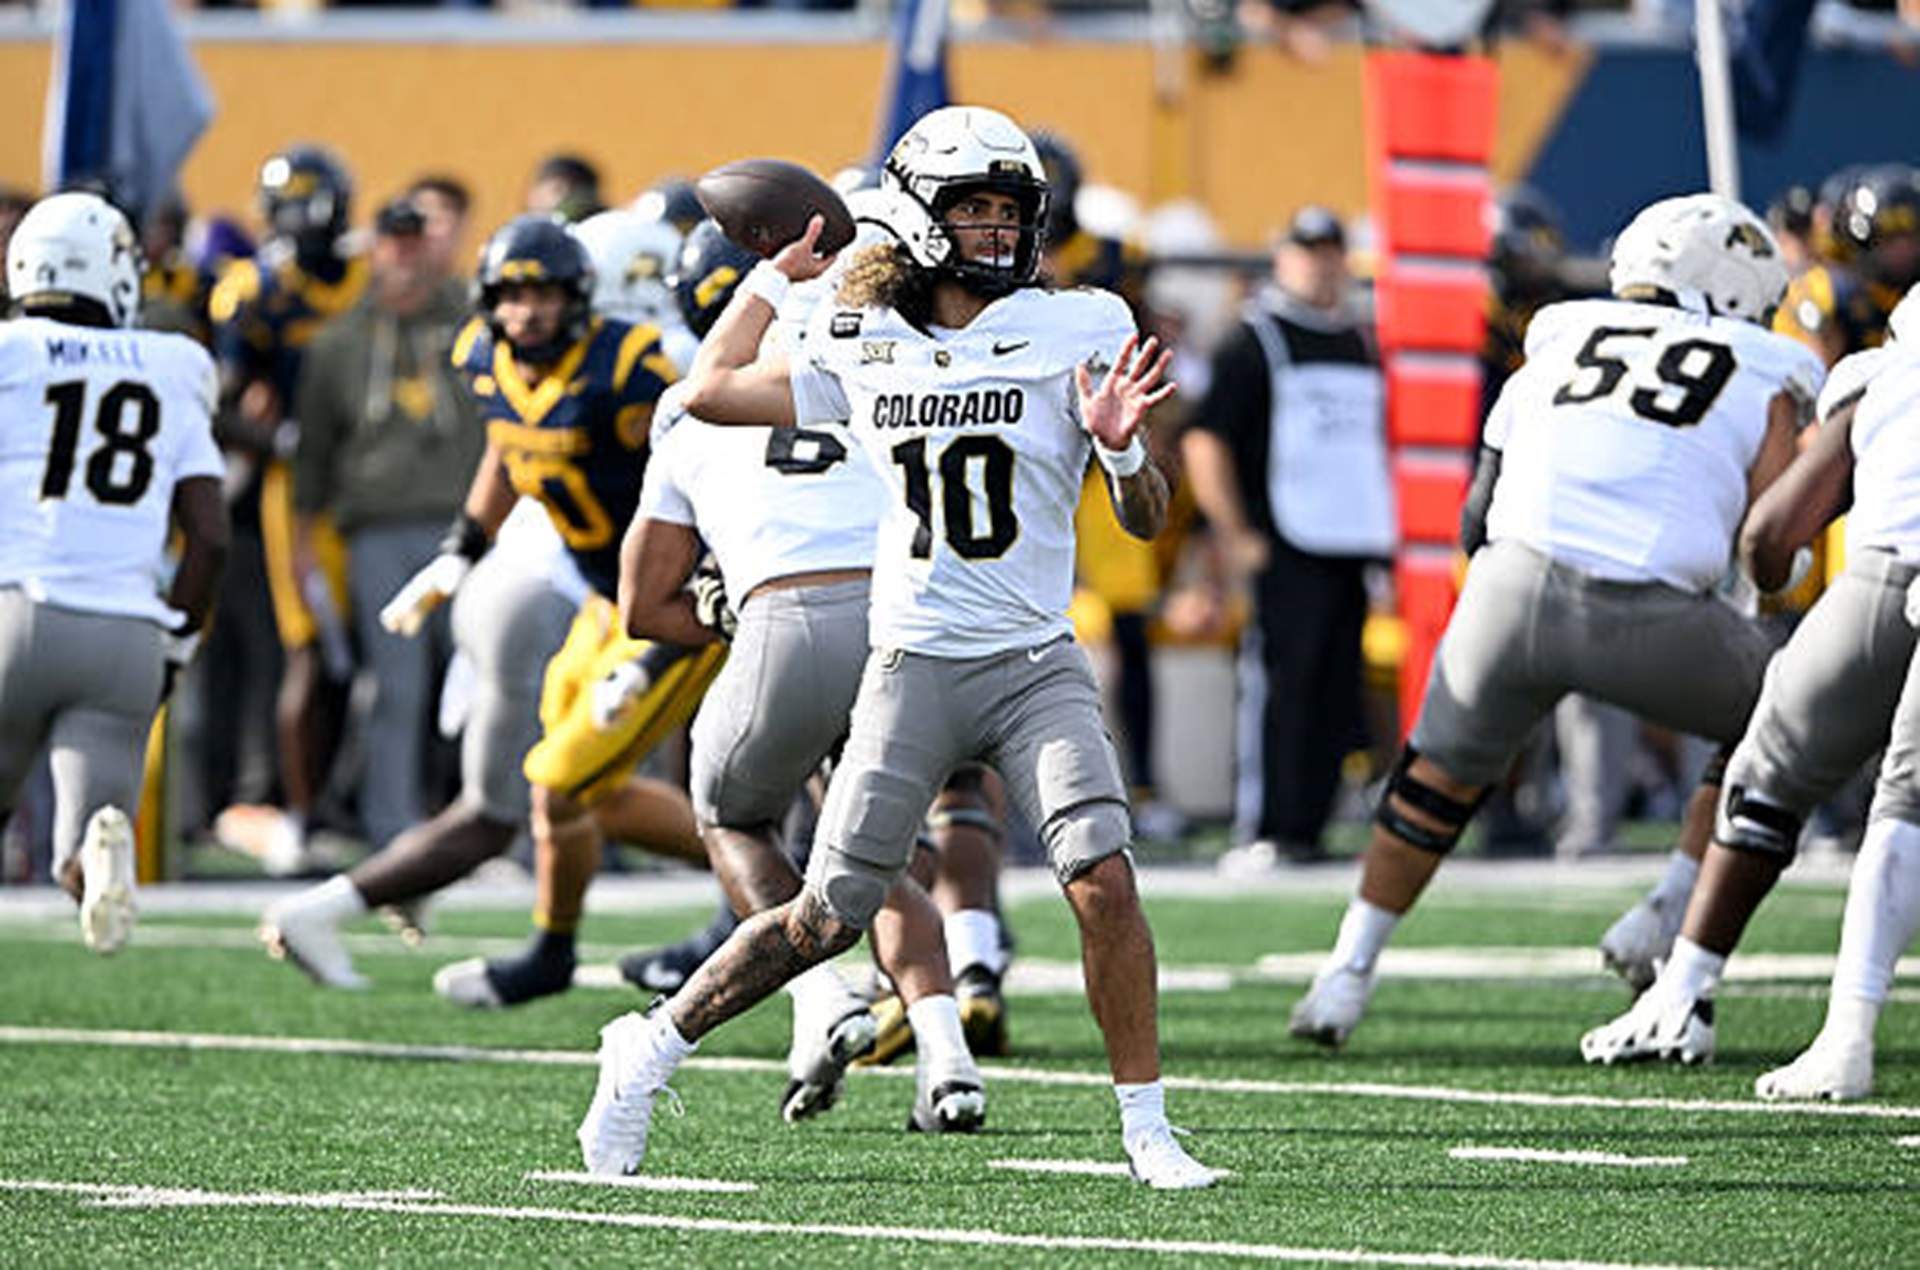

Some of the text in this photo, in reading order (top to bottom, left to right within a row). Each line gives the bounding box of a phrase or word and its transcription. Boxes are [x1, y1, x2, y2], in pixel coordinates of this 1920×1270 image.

[873, 388, 1023, 429] COLORADO
[1553, 325, 1737, 427] 59
[41, 378, 161, 506] 18
[891, 431, 1019, 560] 10
